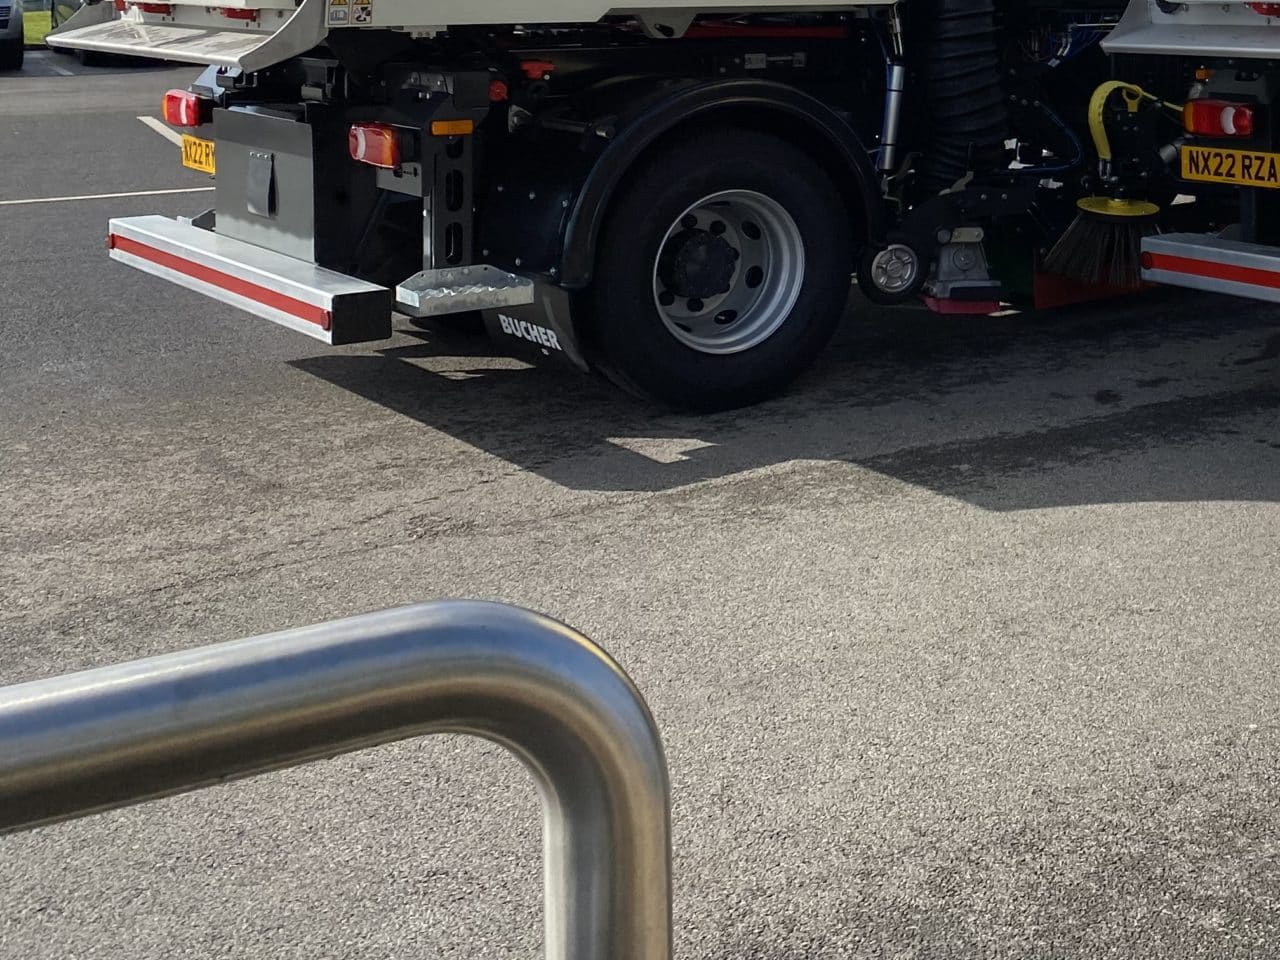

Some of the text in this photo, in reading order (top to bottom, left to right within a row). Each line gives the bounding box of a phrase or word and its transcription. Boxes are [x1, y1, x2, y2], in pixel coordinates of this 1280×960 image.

[1189, 149, 1278, 183] NX22 RZA
[498, 313, 562, 351] BUCHER
